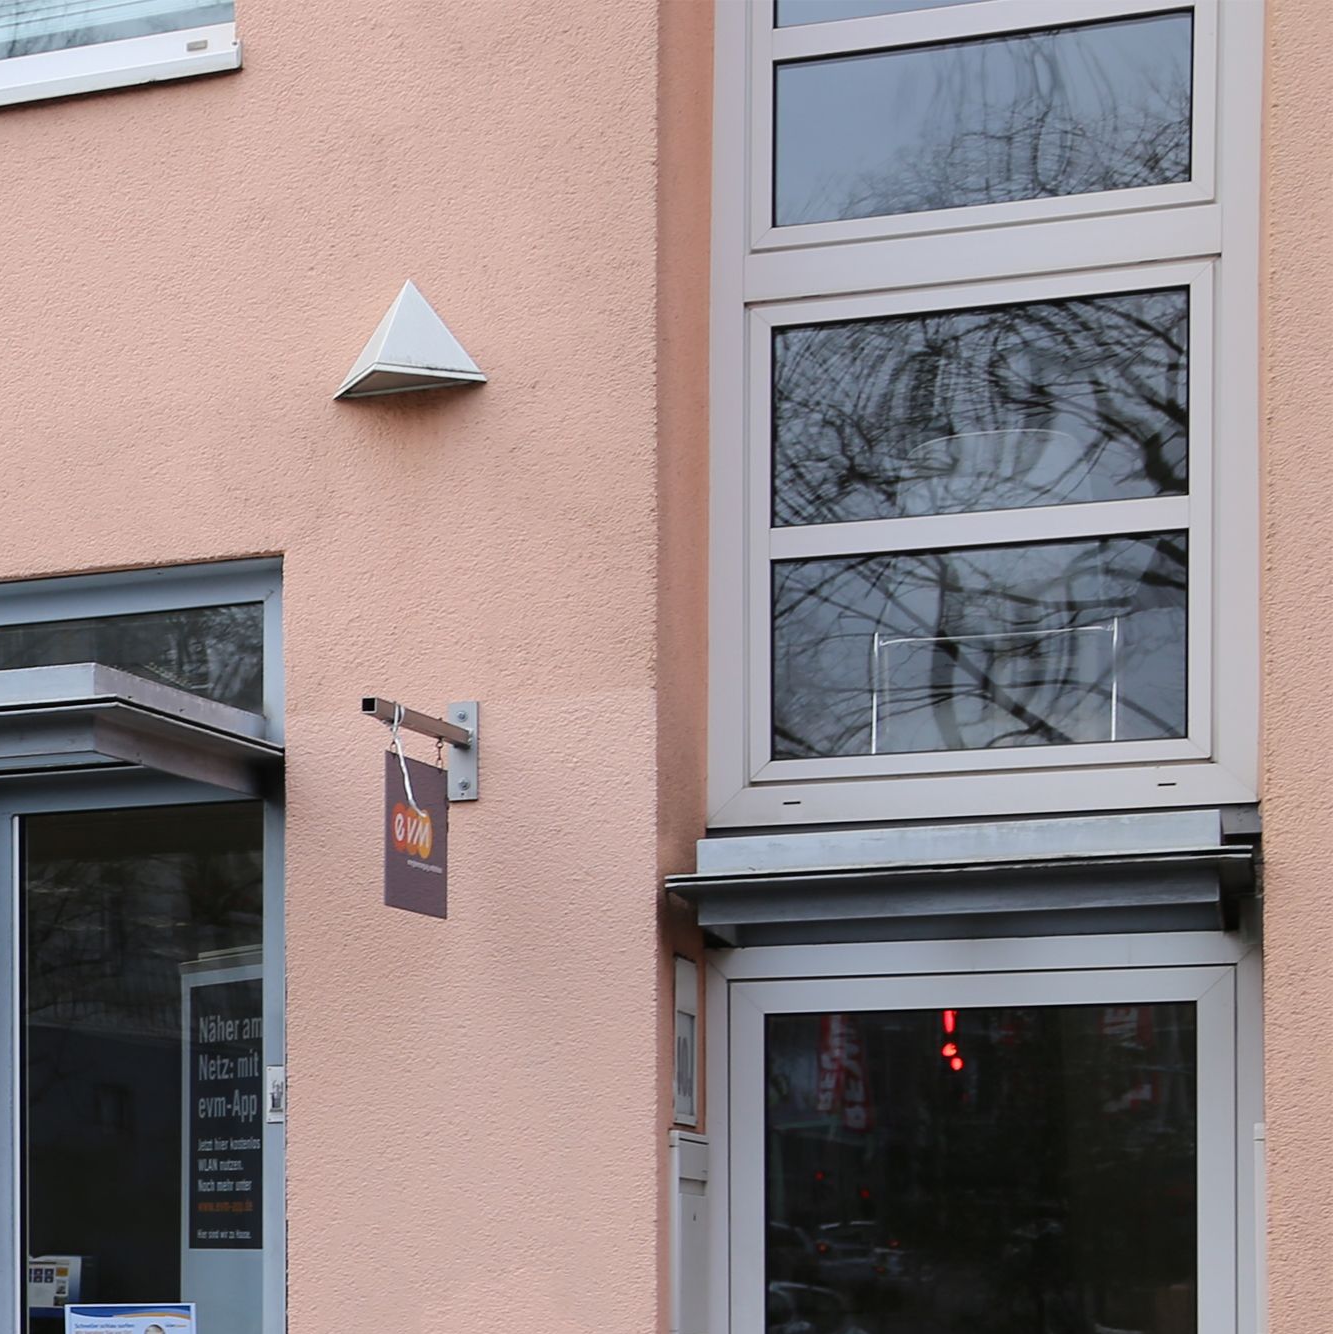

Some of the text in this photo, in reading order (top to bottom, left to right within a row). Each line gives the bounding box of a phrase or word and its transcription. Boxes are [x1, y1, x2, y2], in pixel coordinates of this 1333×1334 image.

[395, 813, 430, 848] evm
[199, 1015, 263, 1044] Näher am
[199, 1049, 259, 1081] Netz: mit
[198, 1089, 257, 1123] evm-App
